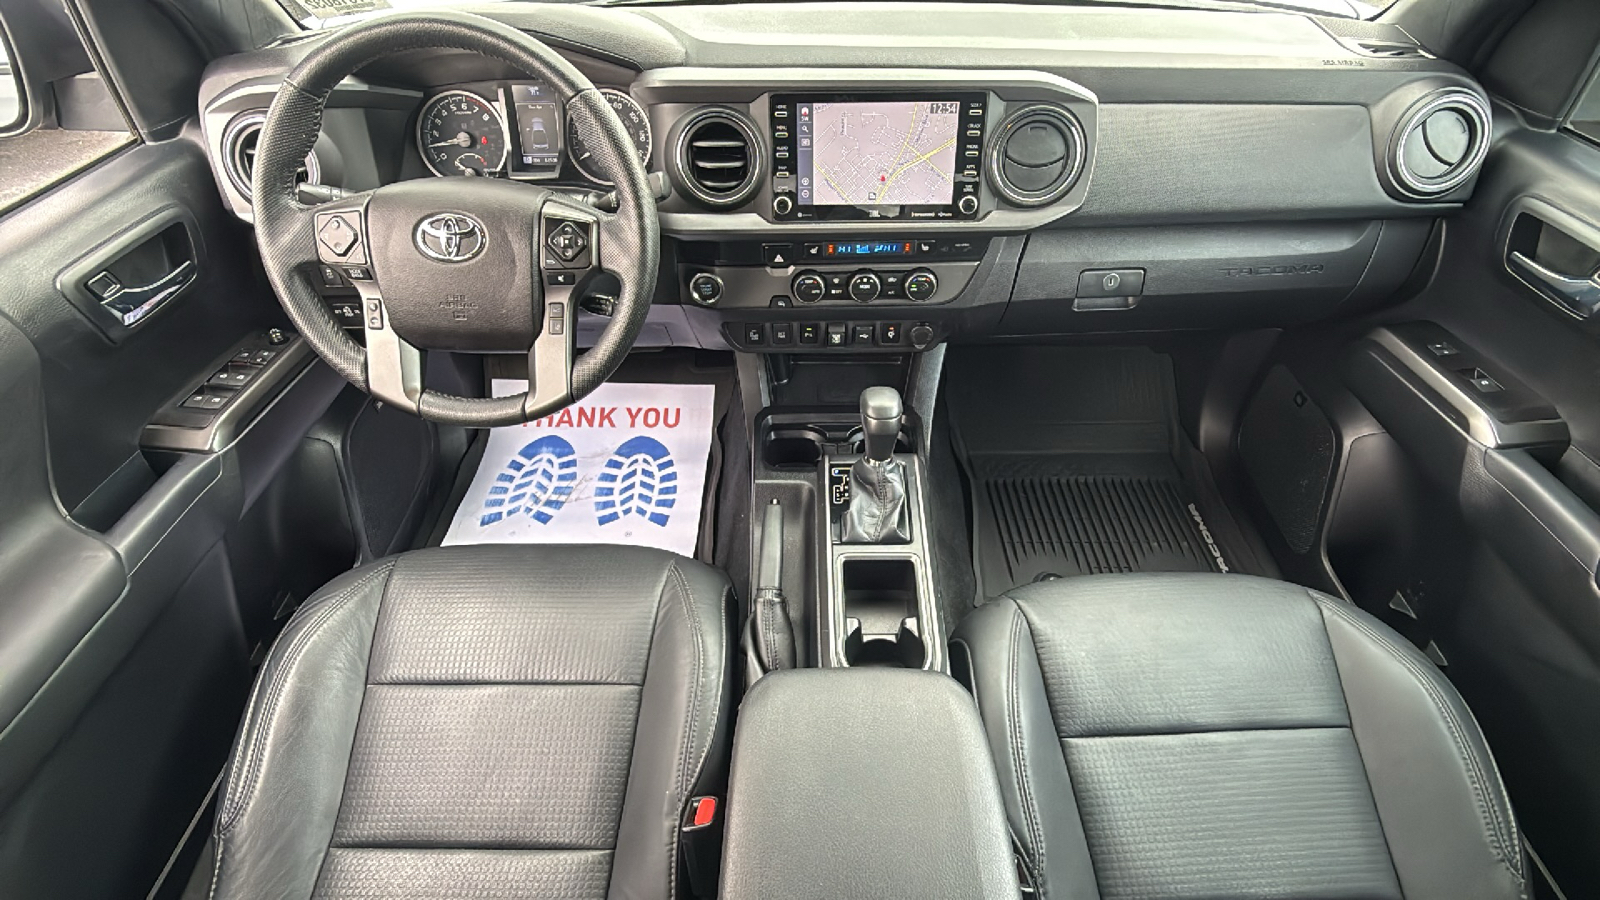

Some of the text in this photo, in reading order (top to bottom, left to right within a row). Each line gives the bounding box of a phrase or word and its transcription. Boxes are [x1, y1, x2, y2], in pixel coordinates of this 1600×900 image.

[450, 103, 457, 112] 5
[473, 105, 480, 113] 7
[932, 103, 956, 114] 12:54
[441, 109, 448, 117] 4
[482, 113, 490, 121] 8
[434, 118, 442, 126] 3
[432, 130, 439, 138] 2
[440, 152, 448, 160] 0
[1216, 265, 1324, 278] TACOMA
[625, 407, 681, 428] YOU
